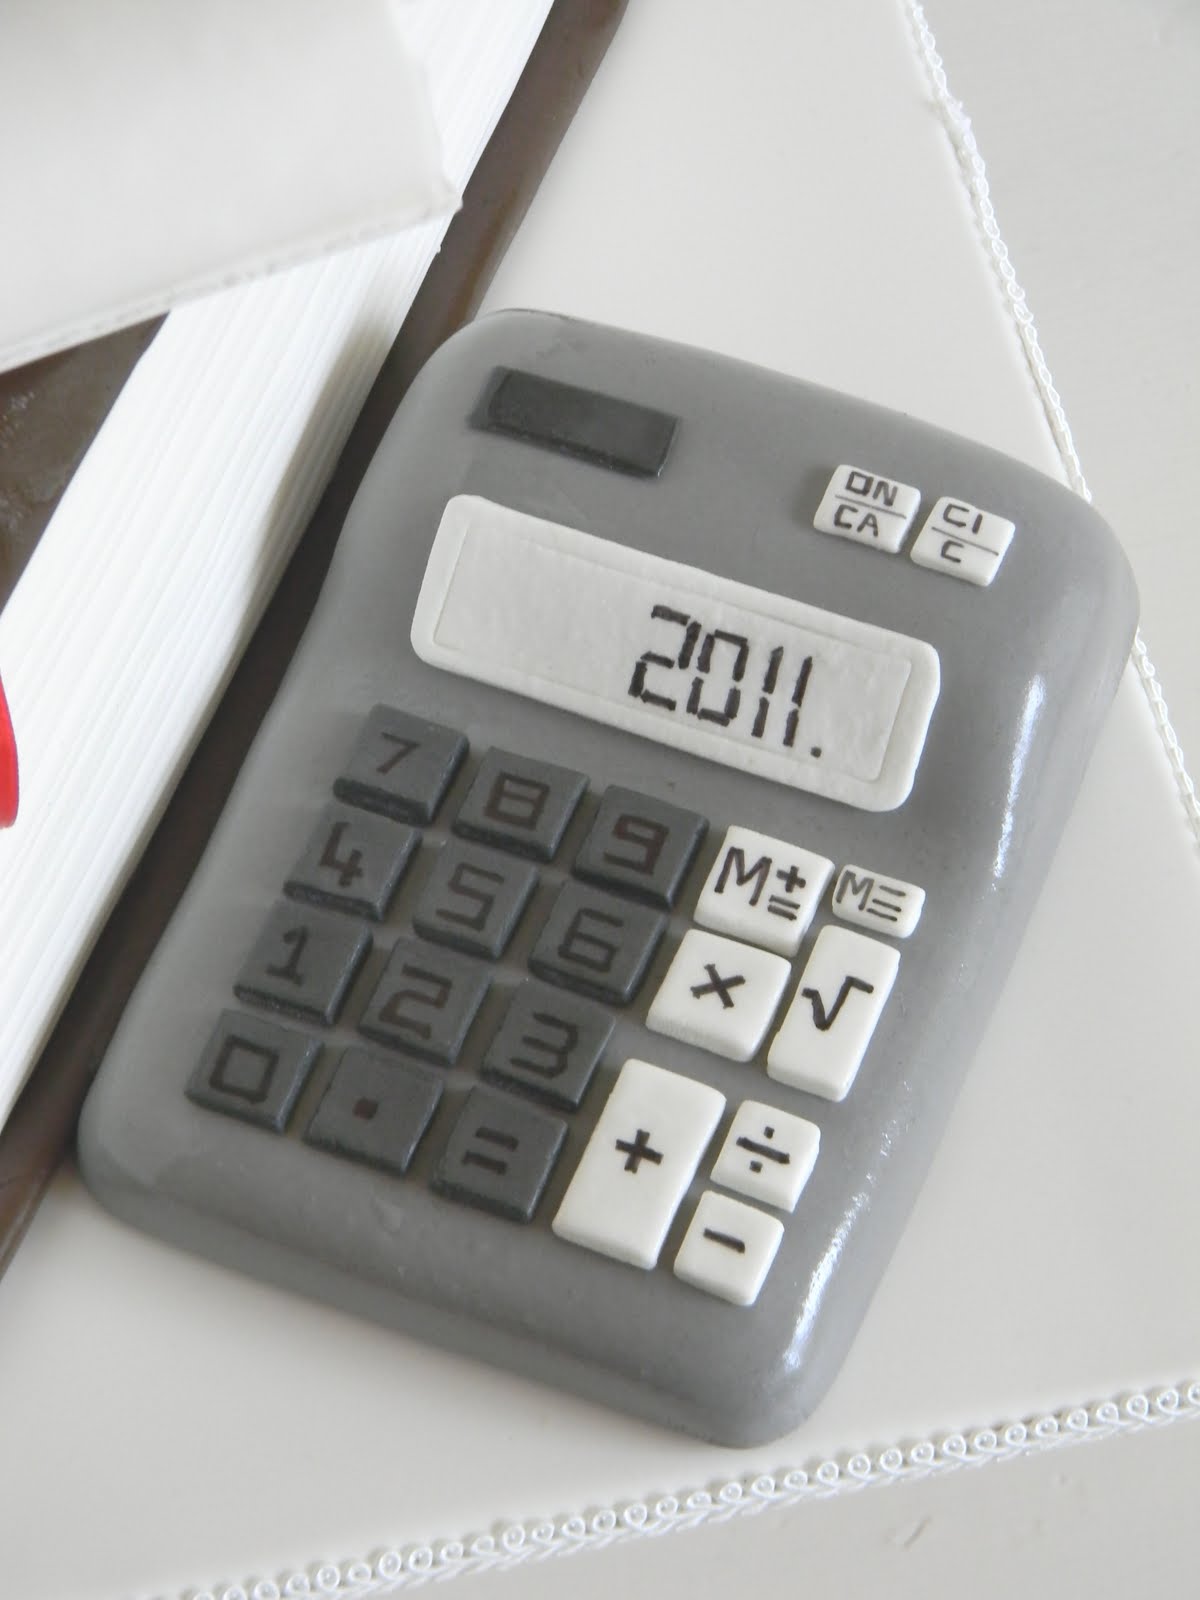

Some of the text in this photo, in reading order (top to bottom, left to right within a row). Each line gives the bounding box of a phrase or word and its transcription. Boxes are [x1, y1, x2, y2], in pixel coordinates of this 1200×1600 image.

[845, 470, 899, 507] ON
[833, 504, 879, 537] CA
[940, 540, 964, 563] C
[376, 732, 421, 775] 7
[483, 771, 550, 831] 8
[319, 821, 363, 887] 4
[603, 813, 670, 876] 9
[435, 862, 504, 931] 5
[267, 926, 309, 985] 1
[558, 907, 625, 972] 6
[379, 964, 453, 1040] 2
[510, 1012, 579, 1079] 3
